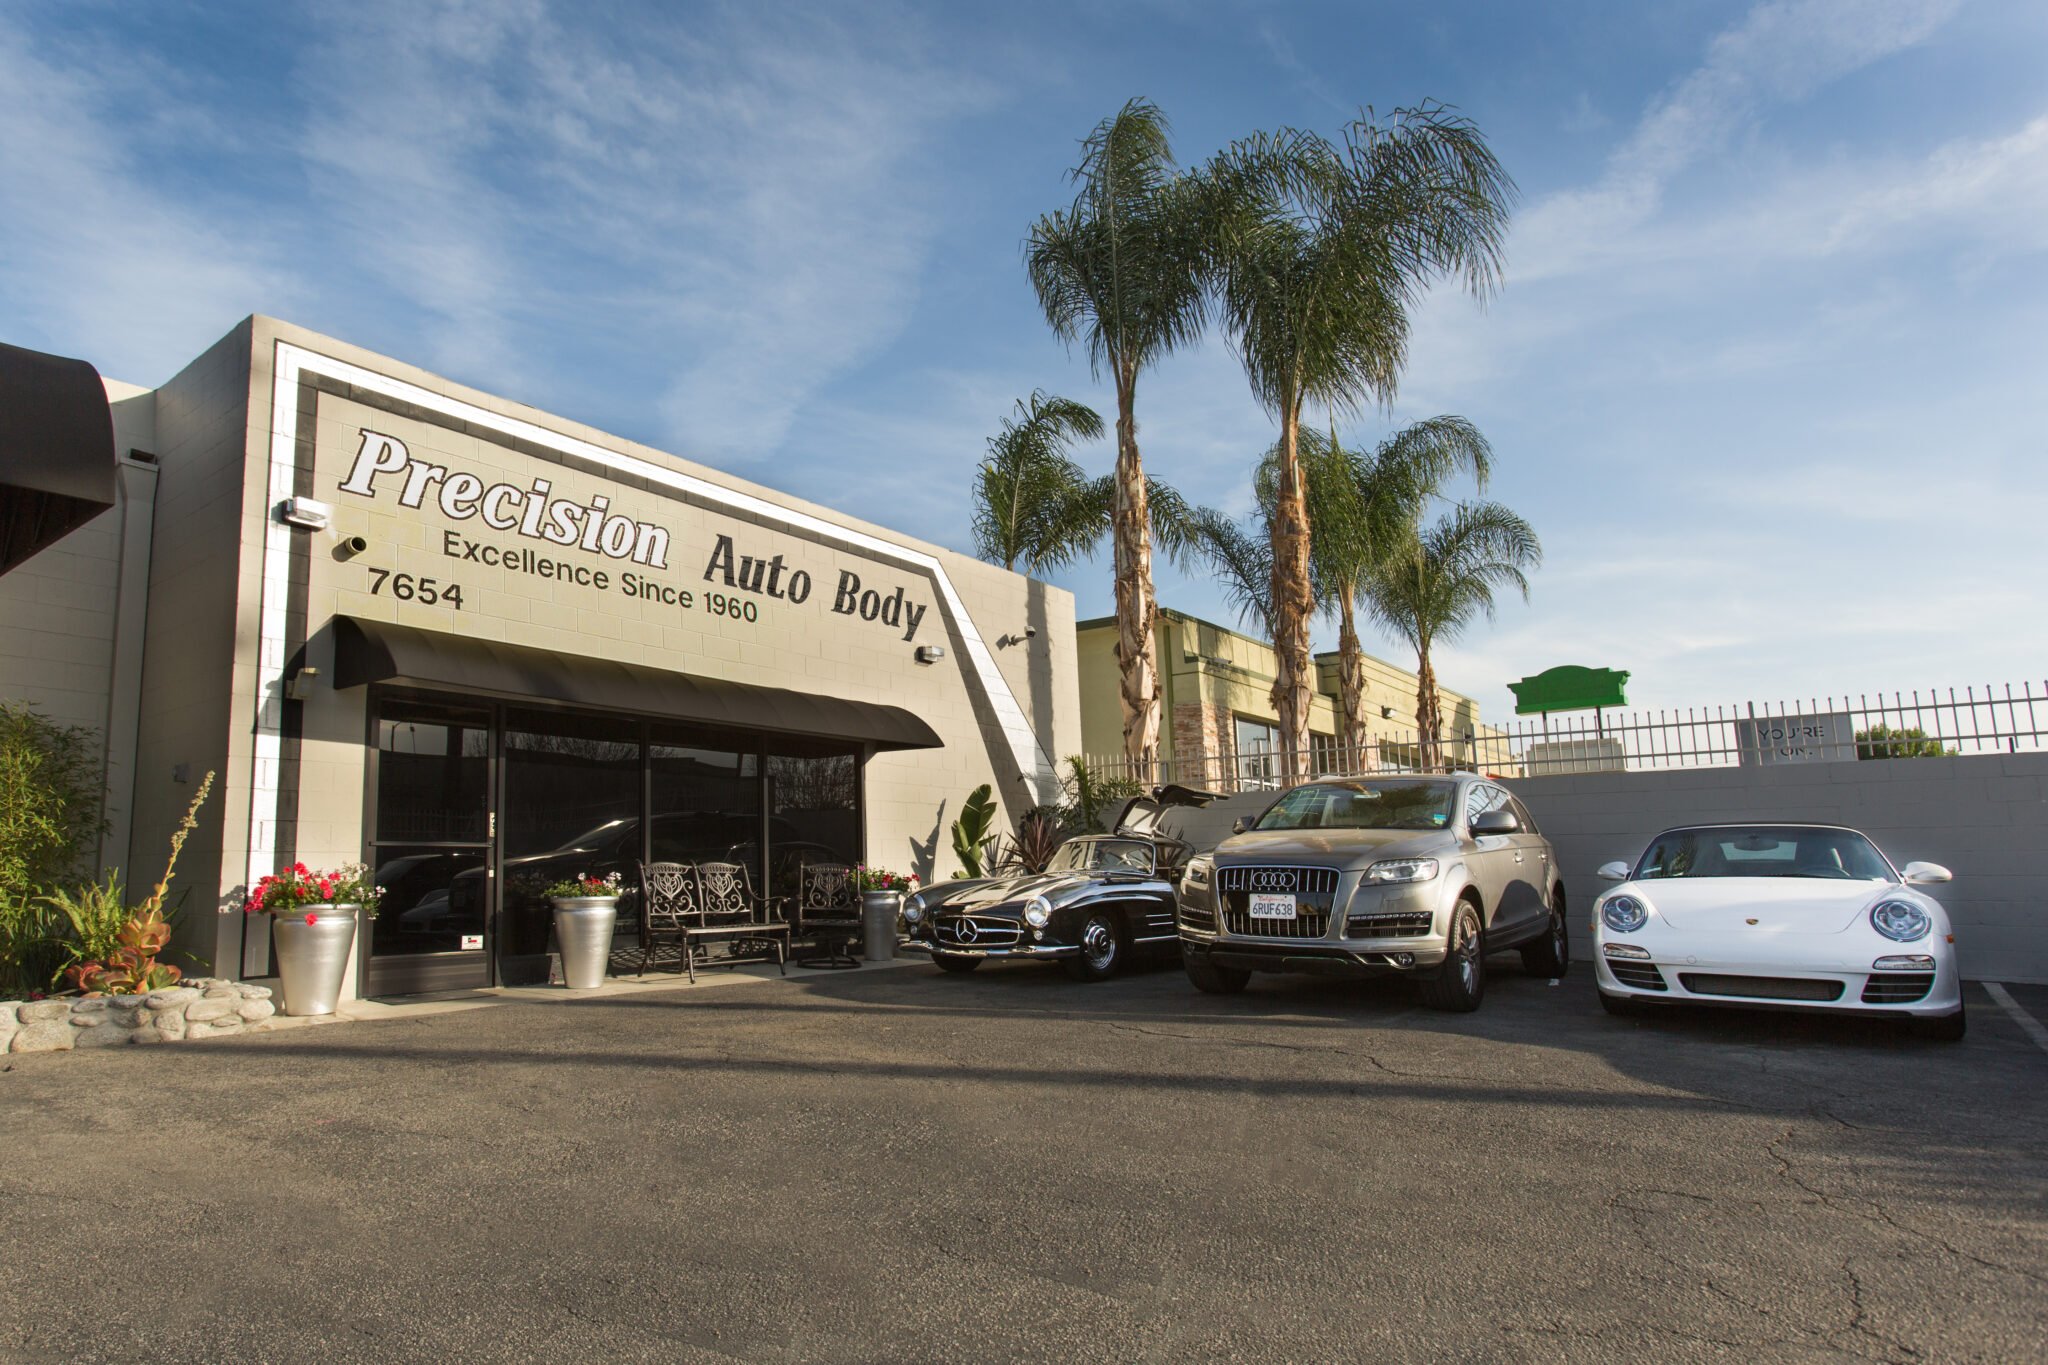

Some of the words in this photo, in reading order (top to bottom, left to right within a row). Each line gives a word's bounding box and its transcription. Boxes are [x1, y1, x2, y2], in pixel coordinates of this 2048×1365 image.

[338, 428, 671, 569] Precision
[703, 533, 811, 604] Auto
[831, 569, 927, 642] Body
[368, 567, 464, 611] 7654
[444, 530, 609, 590] Excellence
[621, 572, 693, 609] Since
[703, 591, 758, 624] 1960
[1758, 726, 1825, 741] YOU'RE
[1252, 902, 1293, 916] 6RUF638
